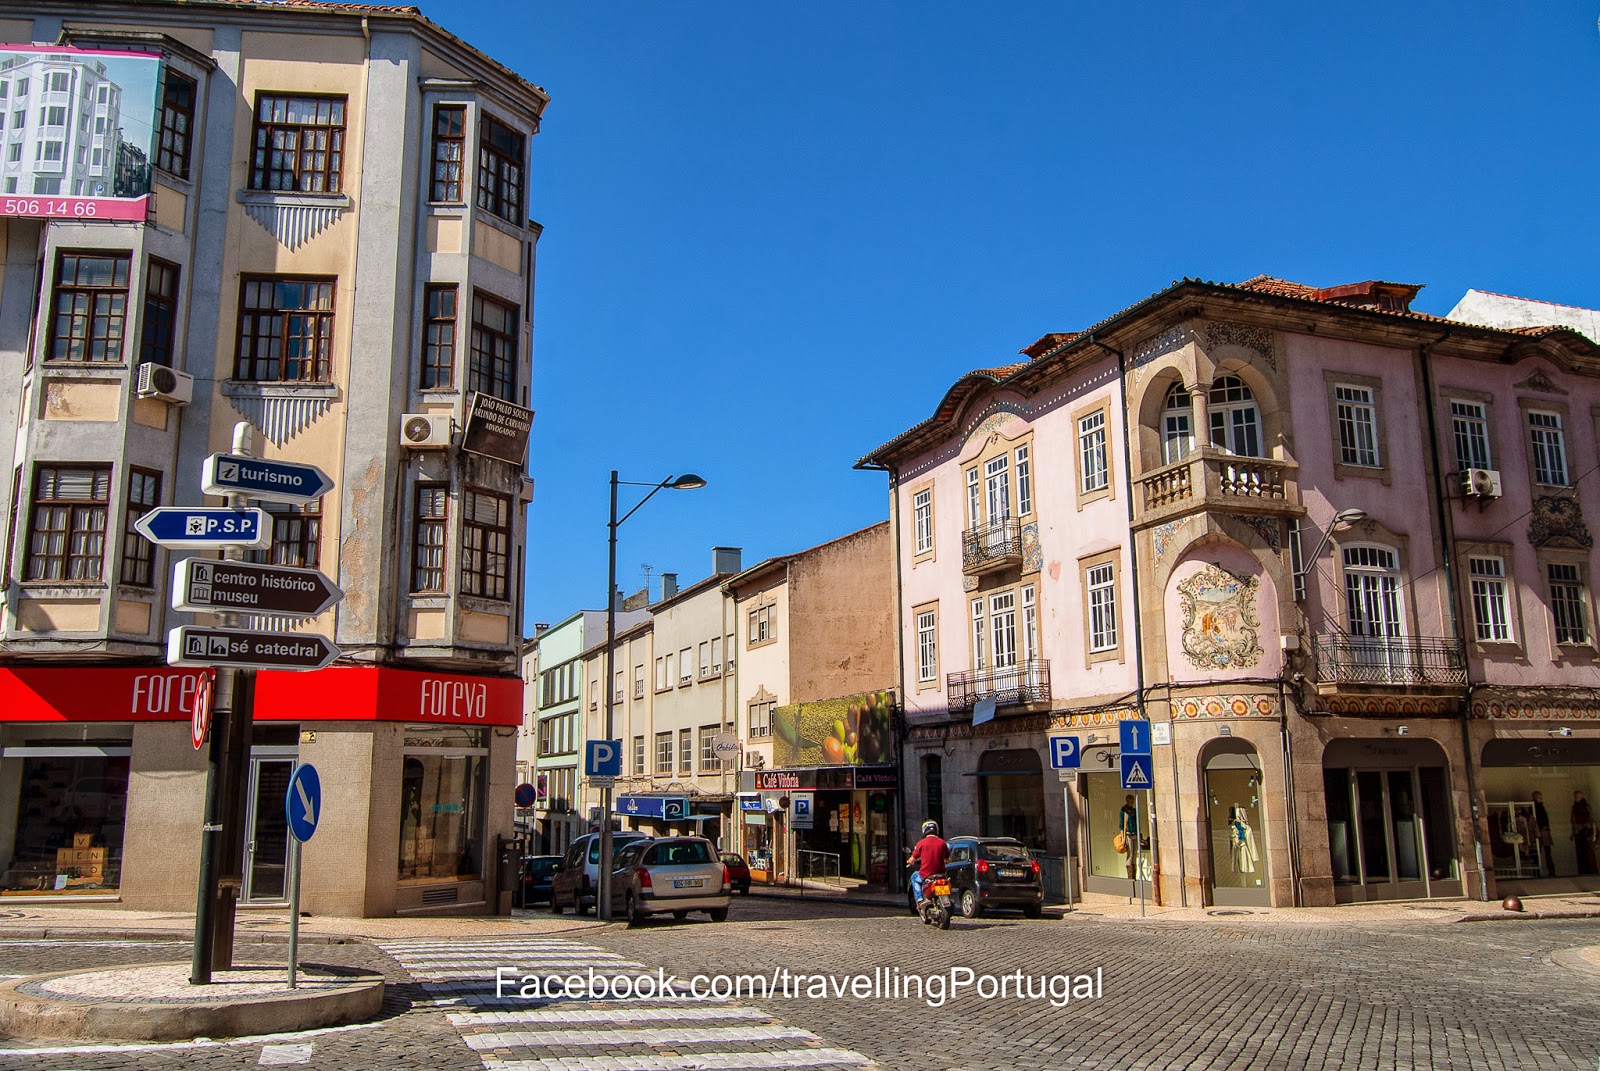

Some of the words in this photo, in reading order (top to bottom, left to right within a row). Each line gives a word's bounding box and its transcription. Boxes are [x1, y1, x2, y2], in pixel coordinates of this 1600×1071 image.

[5, 200, 39, 214] 506
[45, 201, 68, 215] 14
[74, 202, 96, 216] 66
[480, 397, 495, 410] JOÃO
[495, 402, 512, 415] PAULO
[512, 408, 529, 420] SOUSA
[474, 408, 497, 422] ARLINDO
[497, 414, 505, 425] DE
[505, 417, 530, 432] CARVALHO
[485, 423, 515, 437] ADVOGADOS
[240, 467, 303, 486] turismo
[207, 518, 256, 533] P.S.P.
[214, 571, 257, 586] centro
[261, 573, 316, 592] histórico
[213, 590, 258, 604] museu
[230, 639, 249, 654] sé
[255, 642, 319, 657] catedral
[132, 674, 197, 713] Fore
[592, 743, 614, 773] P
[1056, 738, 1075, 767] P
[763, 773, 777, 788] Café
[777, 772, 799, 788] Vitória
[856, 773, 872, 783] Café
[873, 773, 897, 783] Vitória
[798, 801, 807, 813] P
